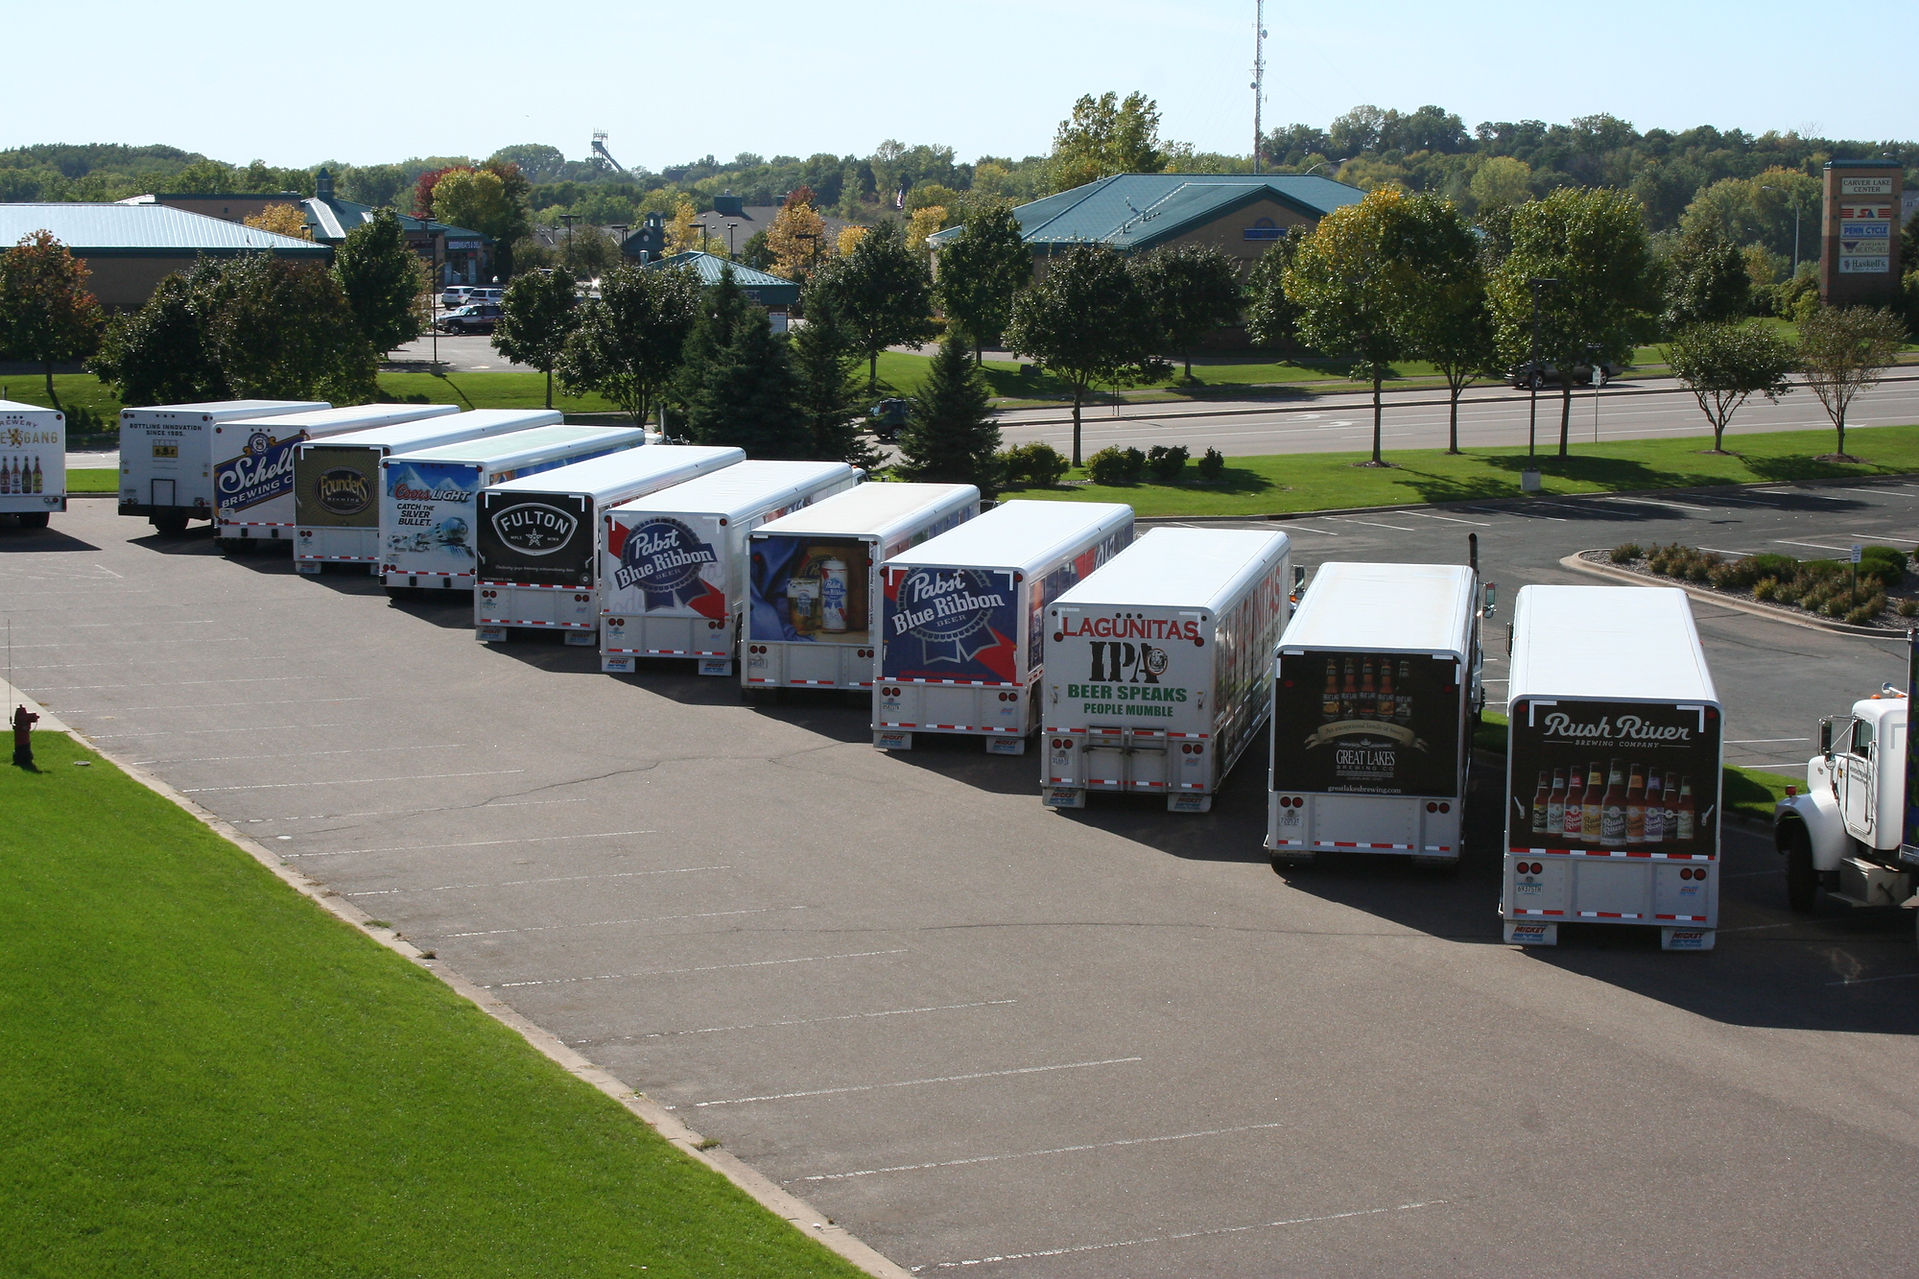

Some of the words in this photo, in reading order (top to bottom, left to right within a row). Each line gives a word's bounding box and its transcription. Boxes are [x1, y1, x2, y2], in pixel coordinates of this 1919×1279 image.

[1865, 226, 1888, 234] CYCLE
[222, 480, 280, 508] BREWING
[395, 483, 430, 500] Coors
[431, 490, 471, 501] LIGHT
[398, 518, 432, 527] BULLET.
[401, 510, 430, 518] SILVER
[500, 511, 569, 535] FULTON
[629, 529, 680, 559] Pabst
[617, 563, 654, 588] Blue
[652, 548, 714, 572] Ribbon
[907, 569, 966, 603] Pabst
[892, 608, 935, 636] Blue
[933, 591, 1006, 618] Ribbon
[936, 614, 967, 627] BEER
[1062, 616, 1199, 641] LAGUNITAS
[1088, 641, 1160, 684] IPA
[1067, 684, 1112, 699] BEER
[1117, 686, 1187, 702] SPEAKS
[1083, 703, 1123, 715] PEOPLE
[1126, 705, 1174, 717] MUMBLE
[1543, 712, 1612, 738] Rush
[1615, 714, 1691, 740] River
[1575, 739, 1614, 747] BREWING
[1619, 741, 1660, 749] COMPANY
[1335, 749, 1365, 765] GREAT
[1367, 750, 1396, 766] LAKES
[1327, 784, 1401, 794] greatlakesbrewing.com
